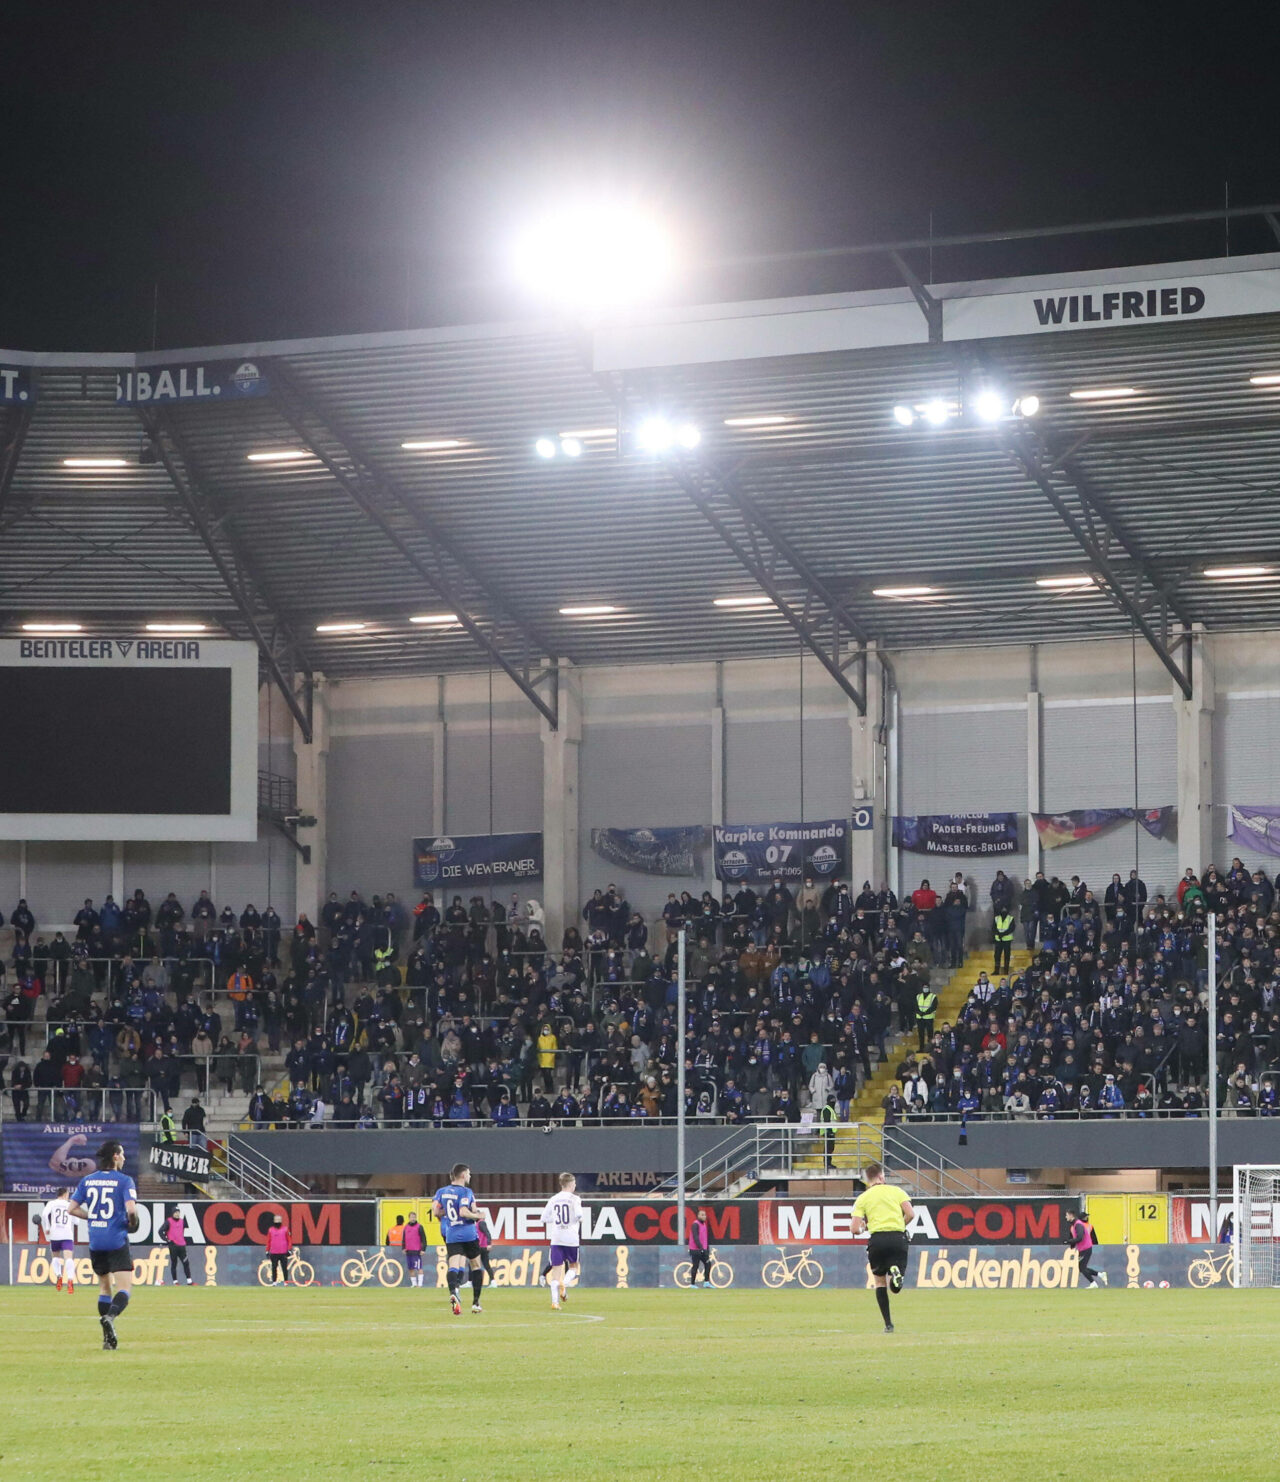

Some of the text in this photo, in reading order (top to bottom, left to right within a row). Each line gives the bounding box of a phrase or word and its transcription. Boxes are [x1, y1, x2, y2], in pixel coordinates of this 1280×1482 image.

[1033, 286, 1206, 326] WILFRIED
[20, 640, 200, 660] BENTELER ARENA
[715, 823, 844, 846] Karpke Kommando
[932, 823, 1006, 834] PADER-FREUNDE
[766, 845, 793, 864] 07
[926, 841, 1014, 854] MARSBERG-BRILON
[442, 859, 535, 878] DIE WEWERANER
[43, 1124, 65, 1133] Auf
[60, 1161, 87, 1172] SCP
[149, 1146, 210, 1175] WEWER
[86, 1186, 115, 1220] 25
[446, 1199, 459, 1222] 6
[1138, 1204, 1156, 1219] 12
[55, 1208, 69, 1225] 26
[481, 1205, 740, 1241] MEIACOM
[553, 1203, 570, 1225] 30
[778, 1203, 1060, 1240] MEACOM
